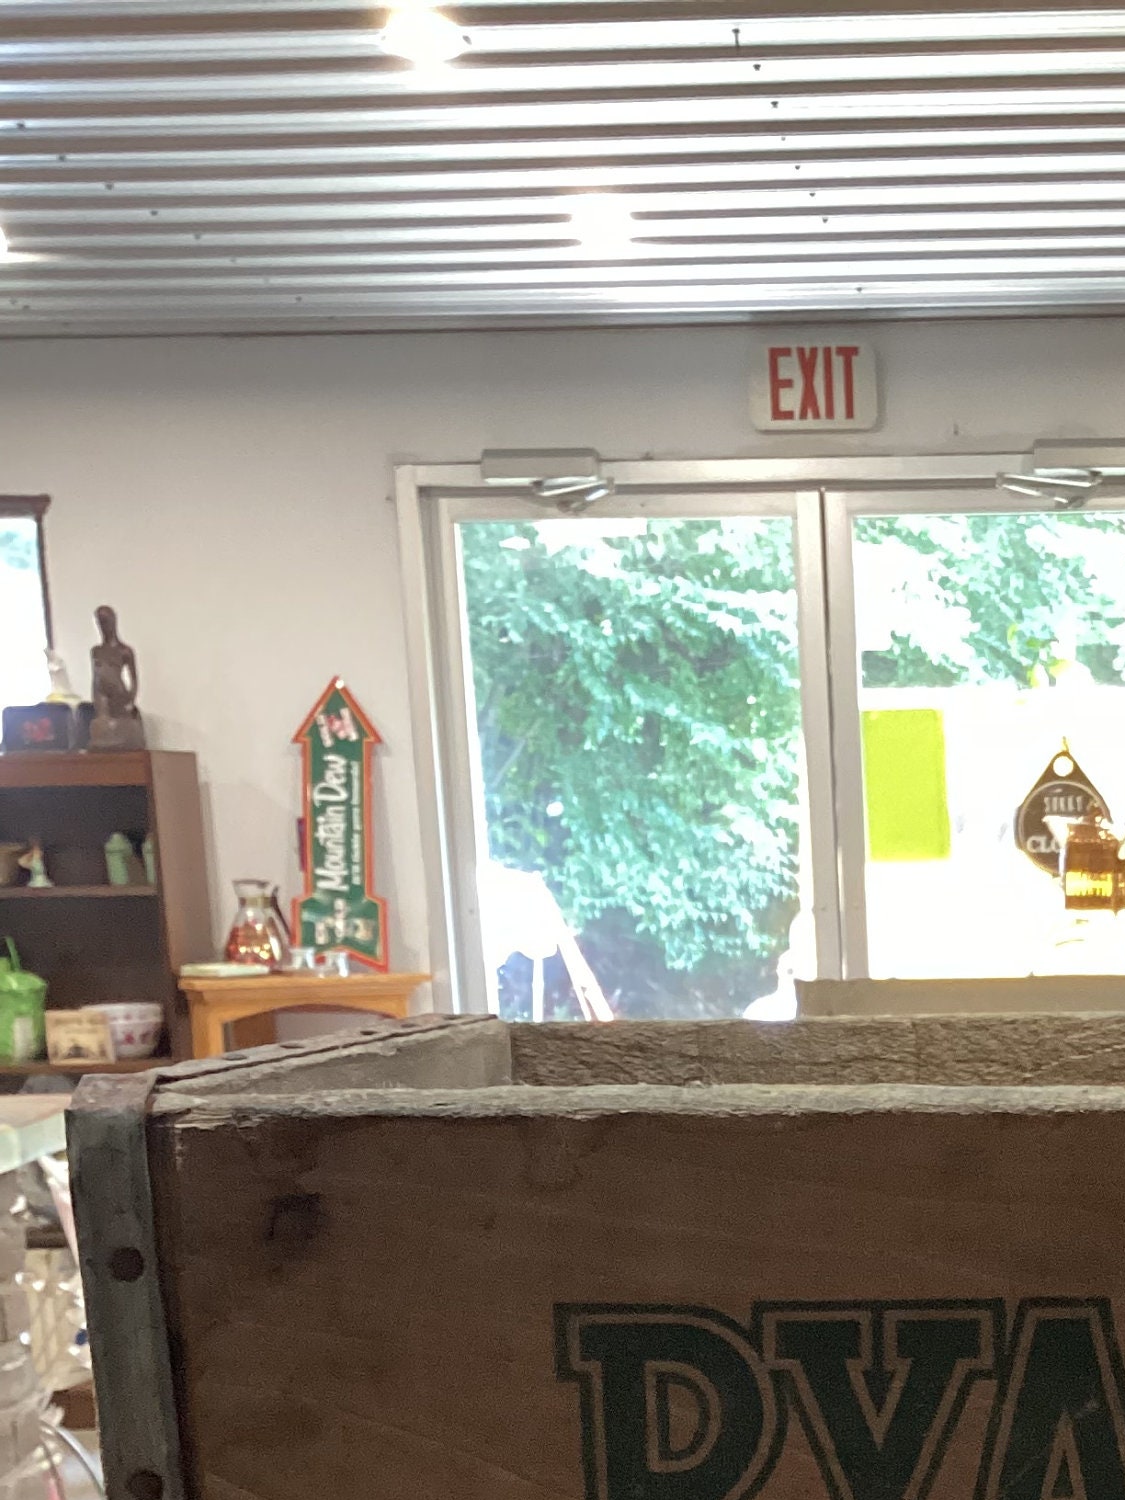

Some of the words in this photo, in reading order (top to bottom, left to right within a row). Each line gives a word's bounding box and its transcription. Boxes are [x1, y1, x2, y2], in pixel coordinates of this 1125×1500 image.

[768, 346, 860, 420] EXIT
[313, 754, 348, 808] Dew
[314, 805, 349, 892] Mountain
